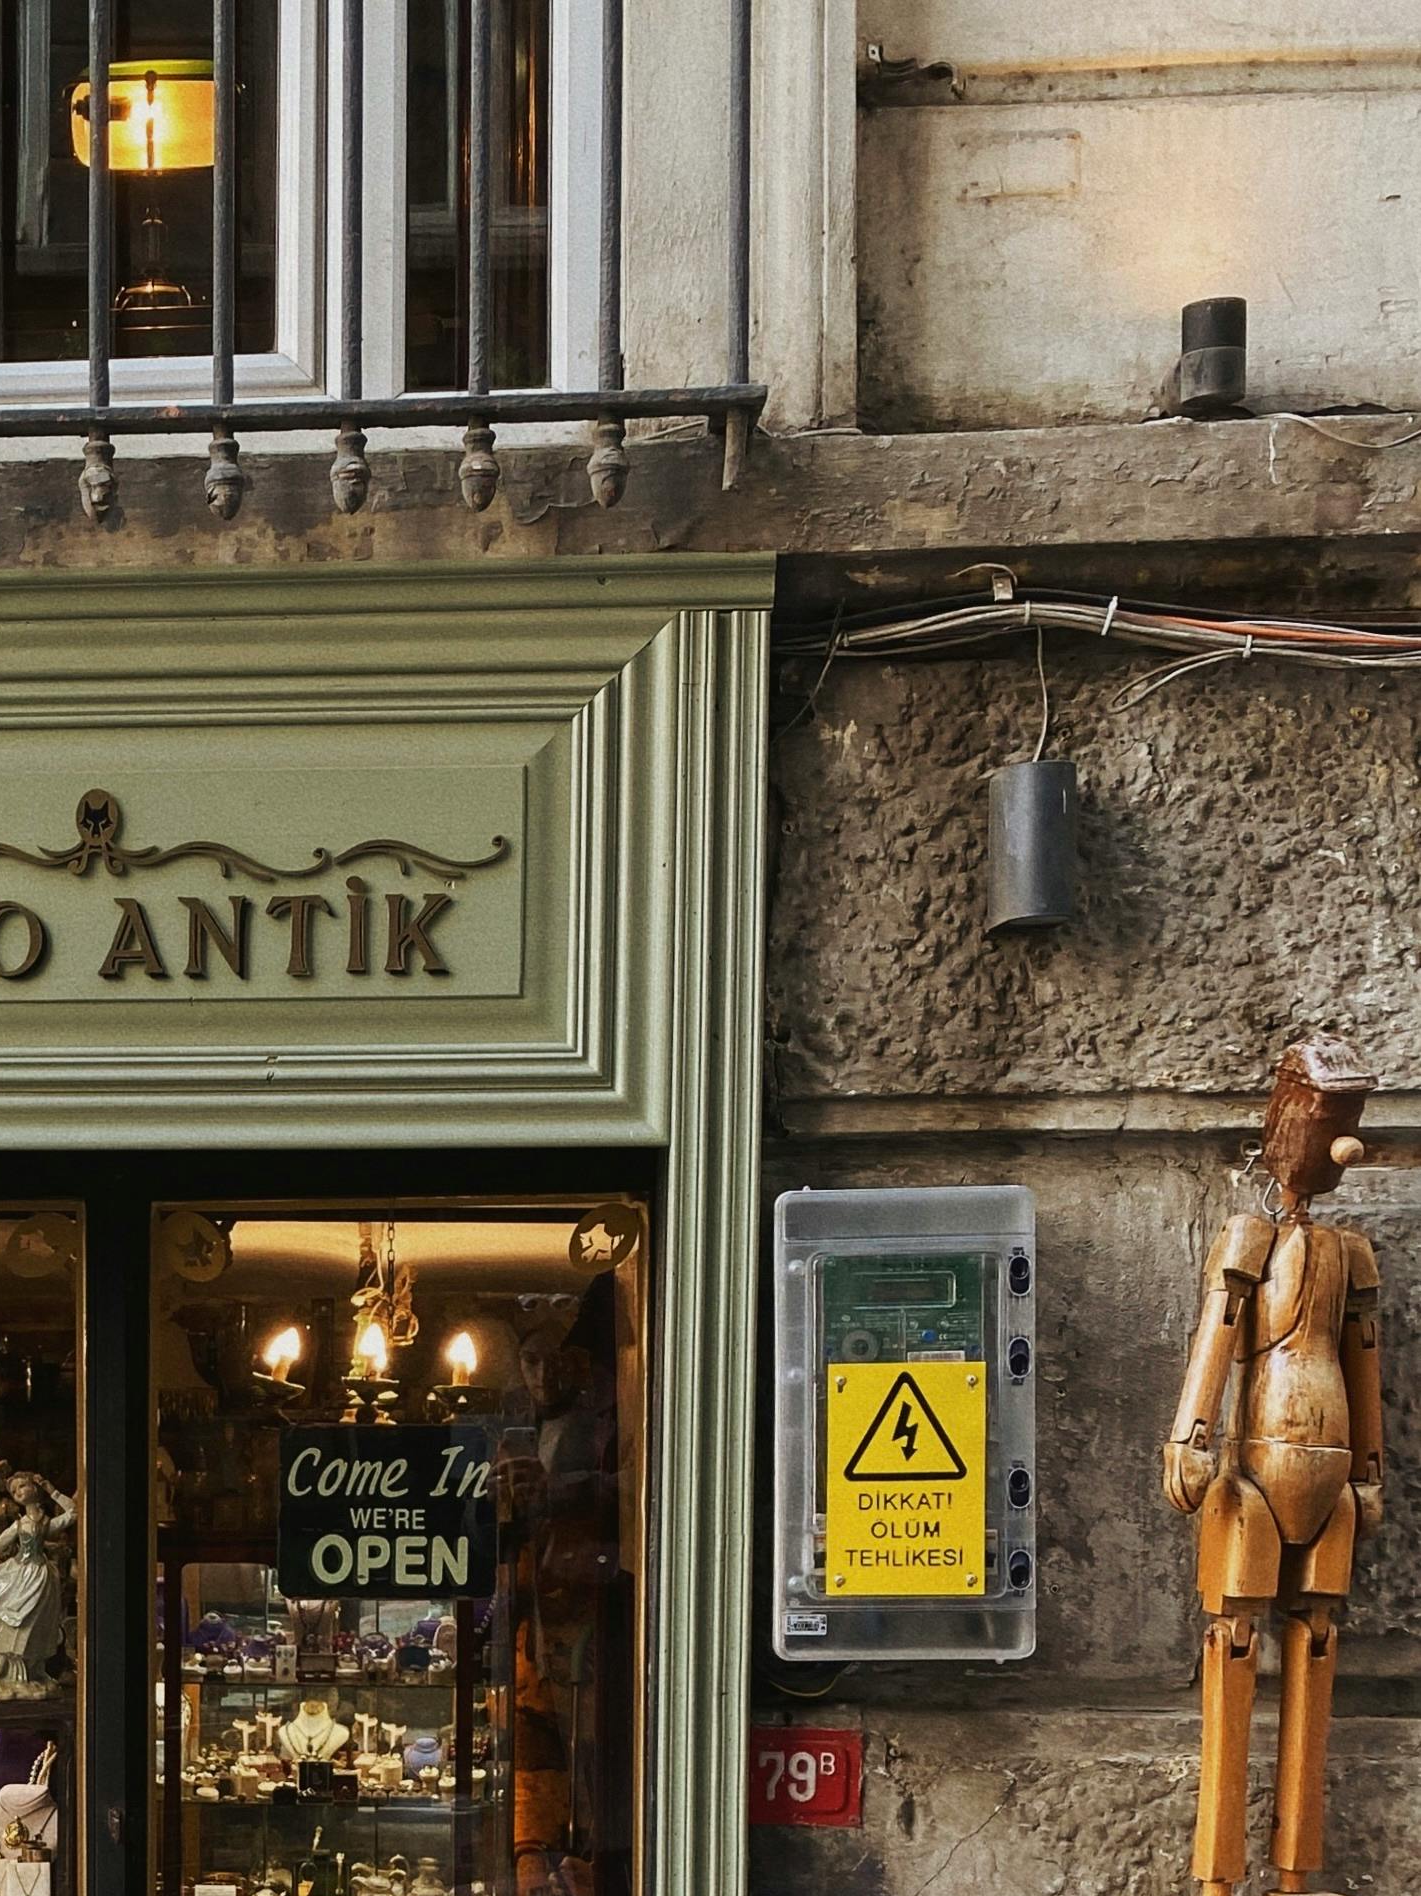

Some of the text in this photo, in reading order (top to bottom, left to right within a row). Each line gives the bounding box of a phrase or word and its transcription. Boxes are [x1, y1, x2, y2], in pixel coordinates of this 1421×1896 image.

[97, 875, 452, 979] ANTİK
[287, 1445, 492, 1498] Come In
[349, 1507, 426, 1530] WE'RE
[871, 1518, 941, 1539] ÖLÜM
[311, 1533, 470, 1586] OPEN
[845, 1546, 964, 1567] TEHLİKESİ
